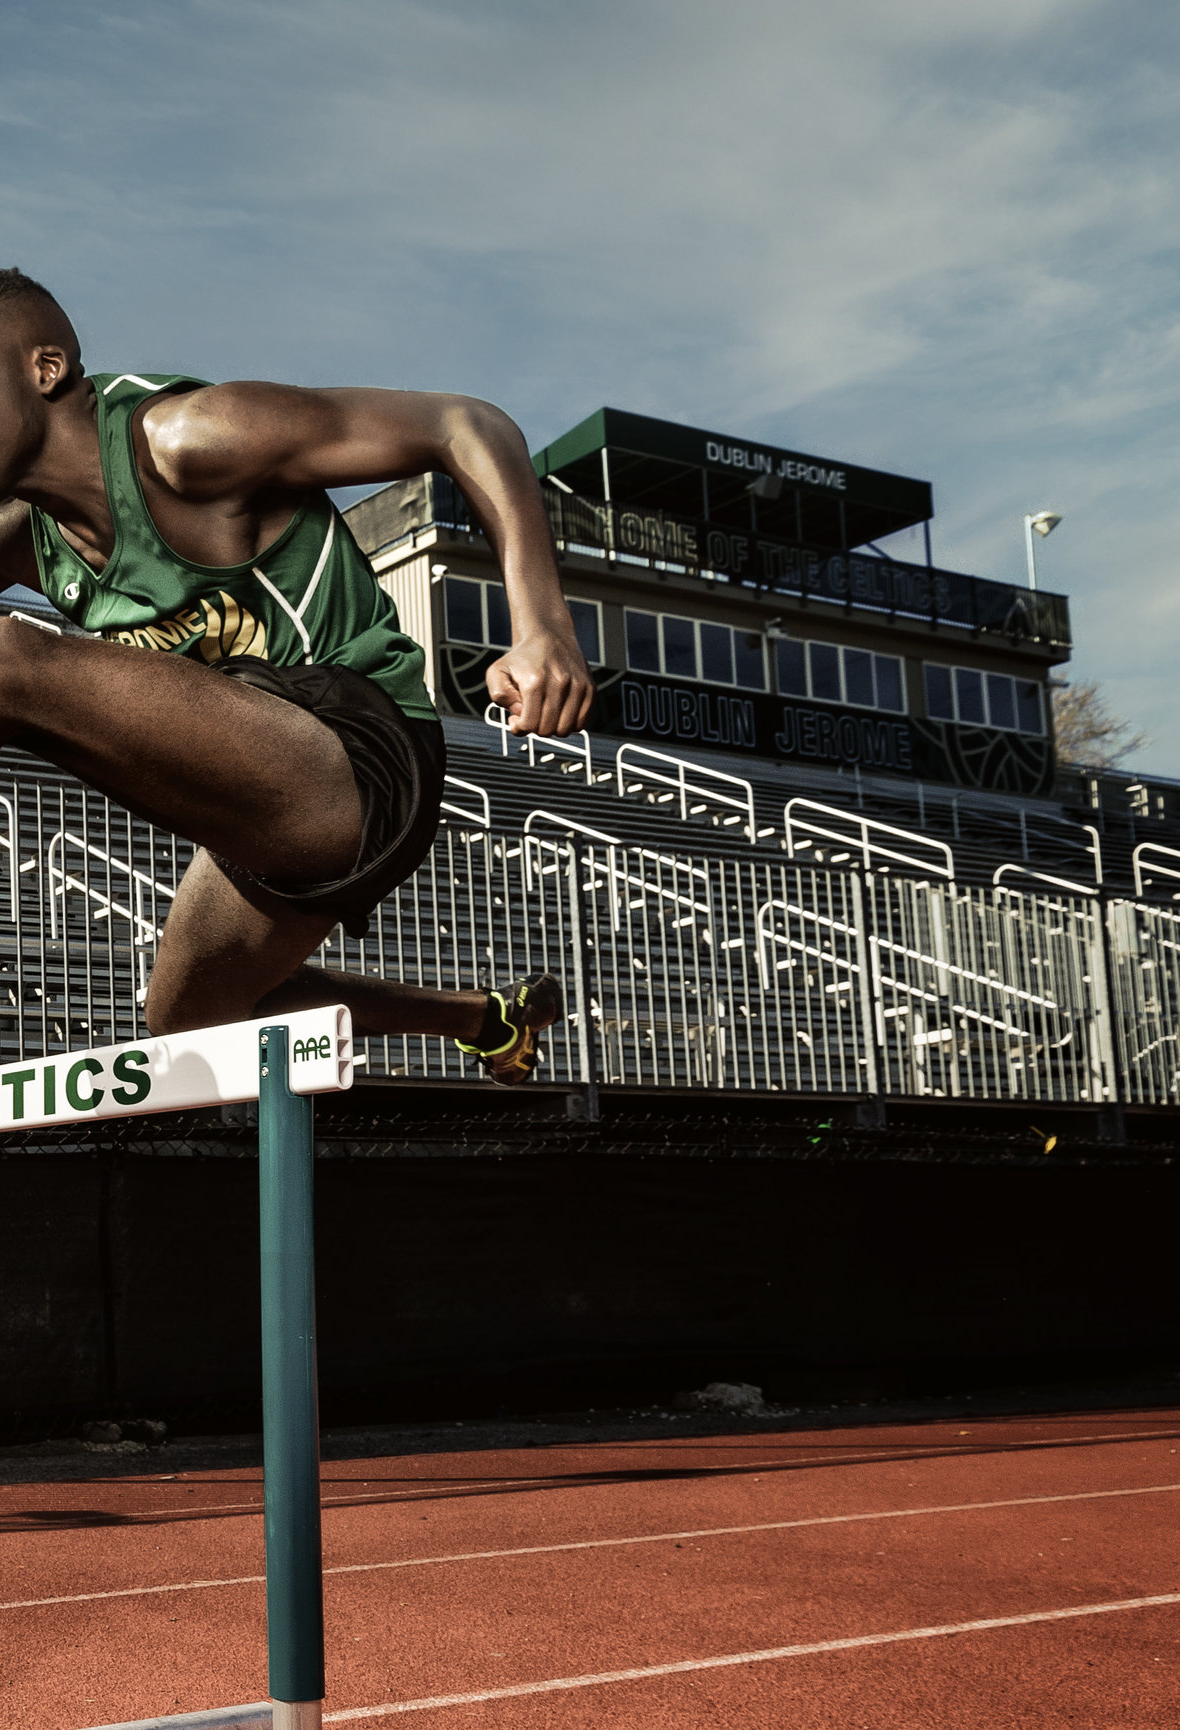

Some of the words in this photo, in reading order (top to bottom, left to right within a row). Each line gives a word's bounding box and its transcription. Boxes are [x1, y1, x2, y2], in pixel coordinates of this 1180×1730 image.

[706, 441, 772, 473] DUBLIN
[775, 458, 848, 491] JEROME
[594, 505, 699, 563] HOME
[706, 530, 749, 573] OF
[756, 540, 822, 588] THE
[826, 555, 953, 613] CELTICS
[621, 681, 756, 747] DUBLIN
[775, 705, 912, 770] JEROME
